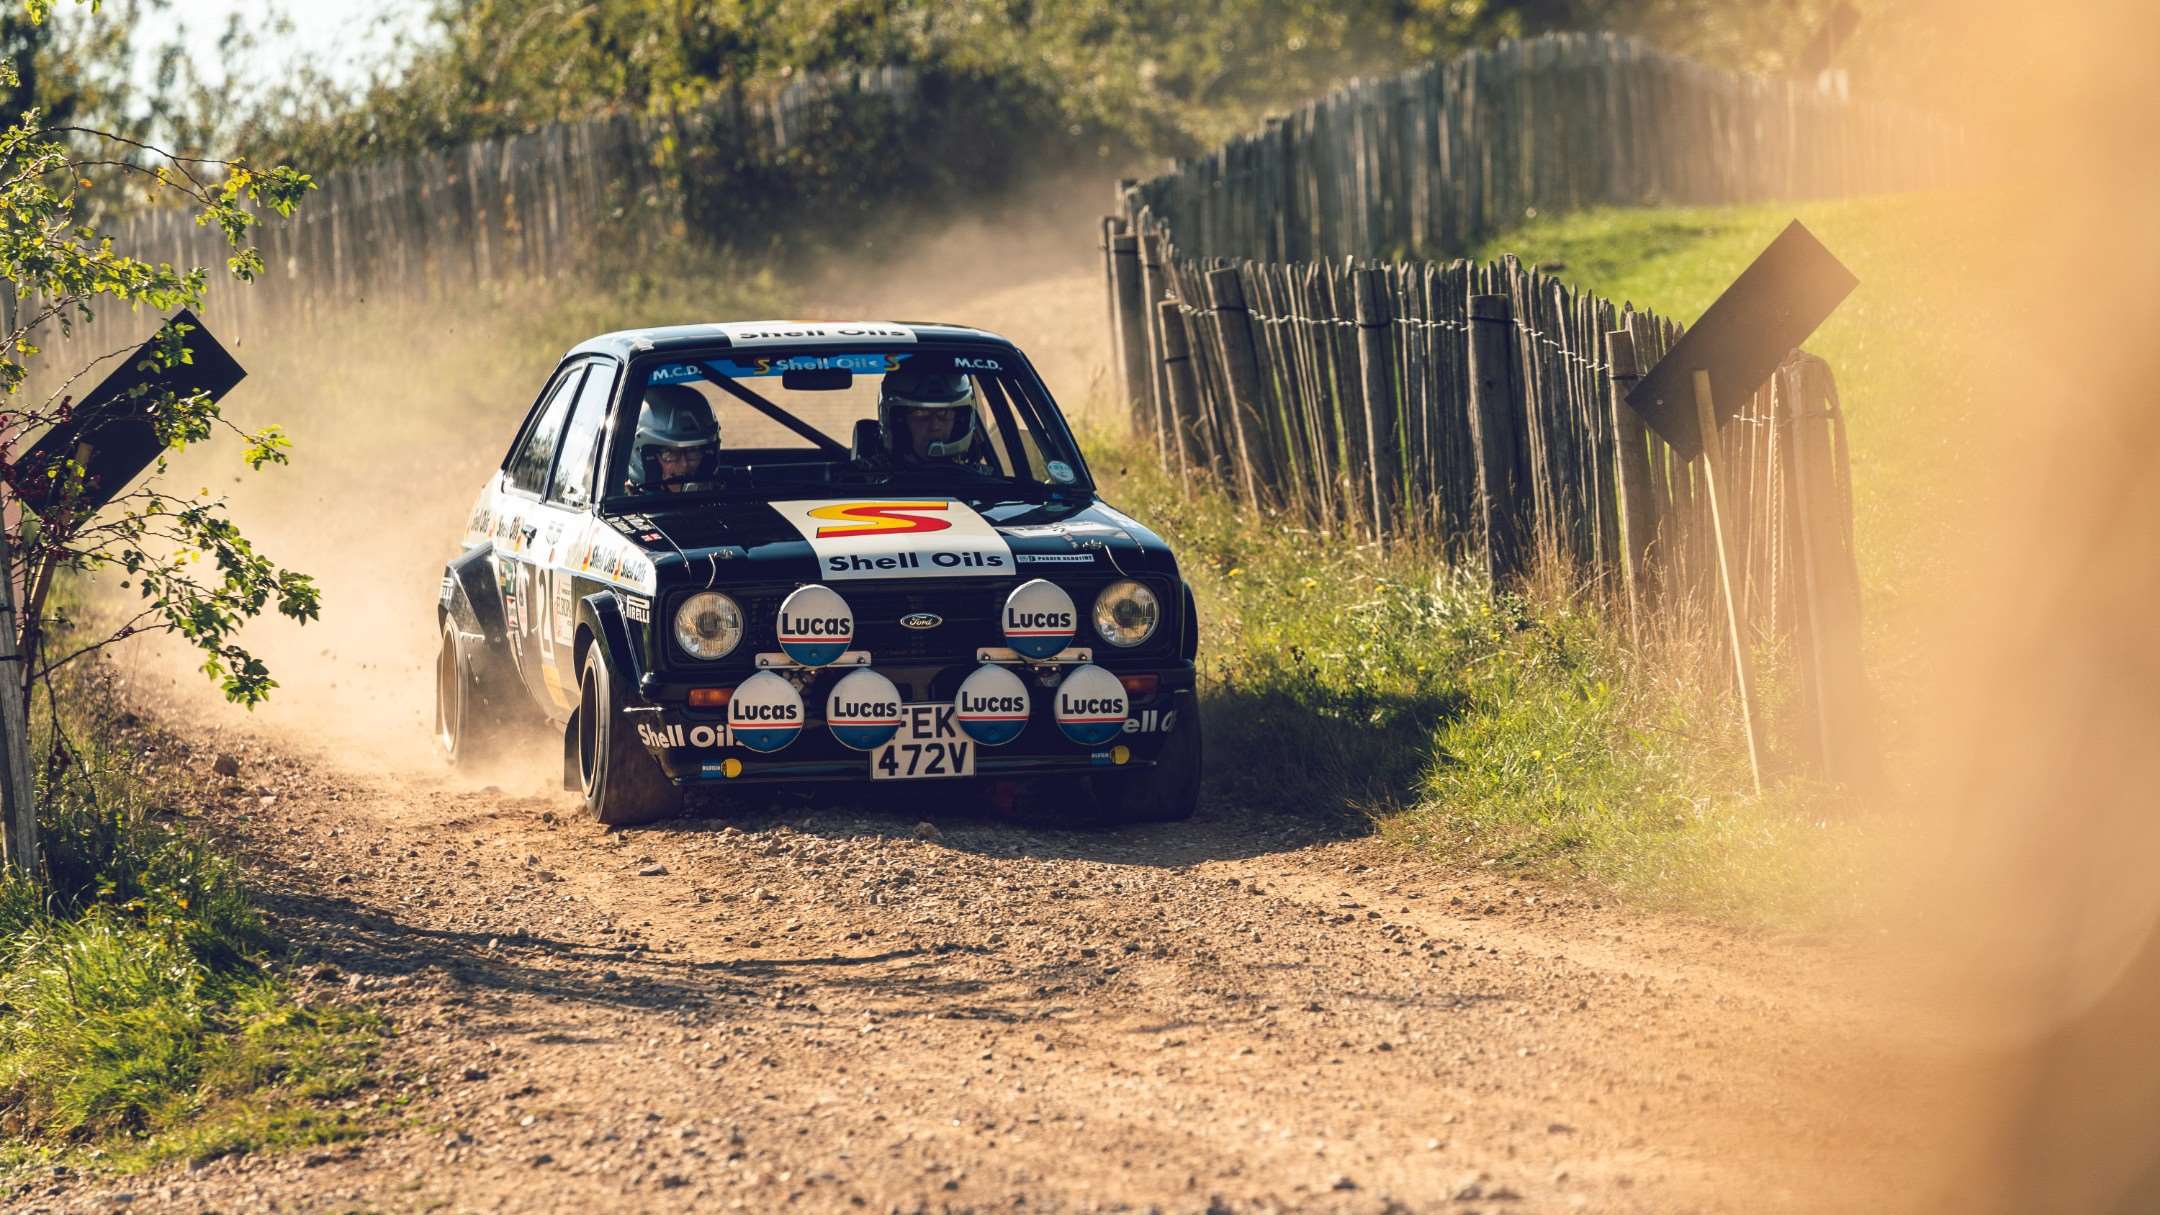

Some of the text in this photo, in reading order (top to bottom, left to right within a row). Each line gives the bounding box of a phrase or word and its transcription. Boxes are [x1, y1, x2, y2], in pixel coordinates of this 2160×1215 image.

[653, 365, 702, 381] M.C.D.
[776, 357, 829, 371] Shell
[953, 357, 1003, 370] M.C.D.
[829, 552, 1004, 571] Shell Oils
[626, 594, 650, 624] PIRELLI
[1008, 607, 1071, 629] Lucas
[781, 613, 851, 636] Lucas
[733, 699, 797, 721] Lucas
[834, 696, 897, 718] Lucas
[962, 691, 1024, 713] Lucas
[1062, 693, 1123, 715] Lucas
[1122, 710, 1158, 733] ell
[637, 724, 743, 749] Shell Oil
[879, 742, 967, 776] 472V
